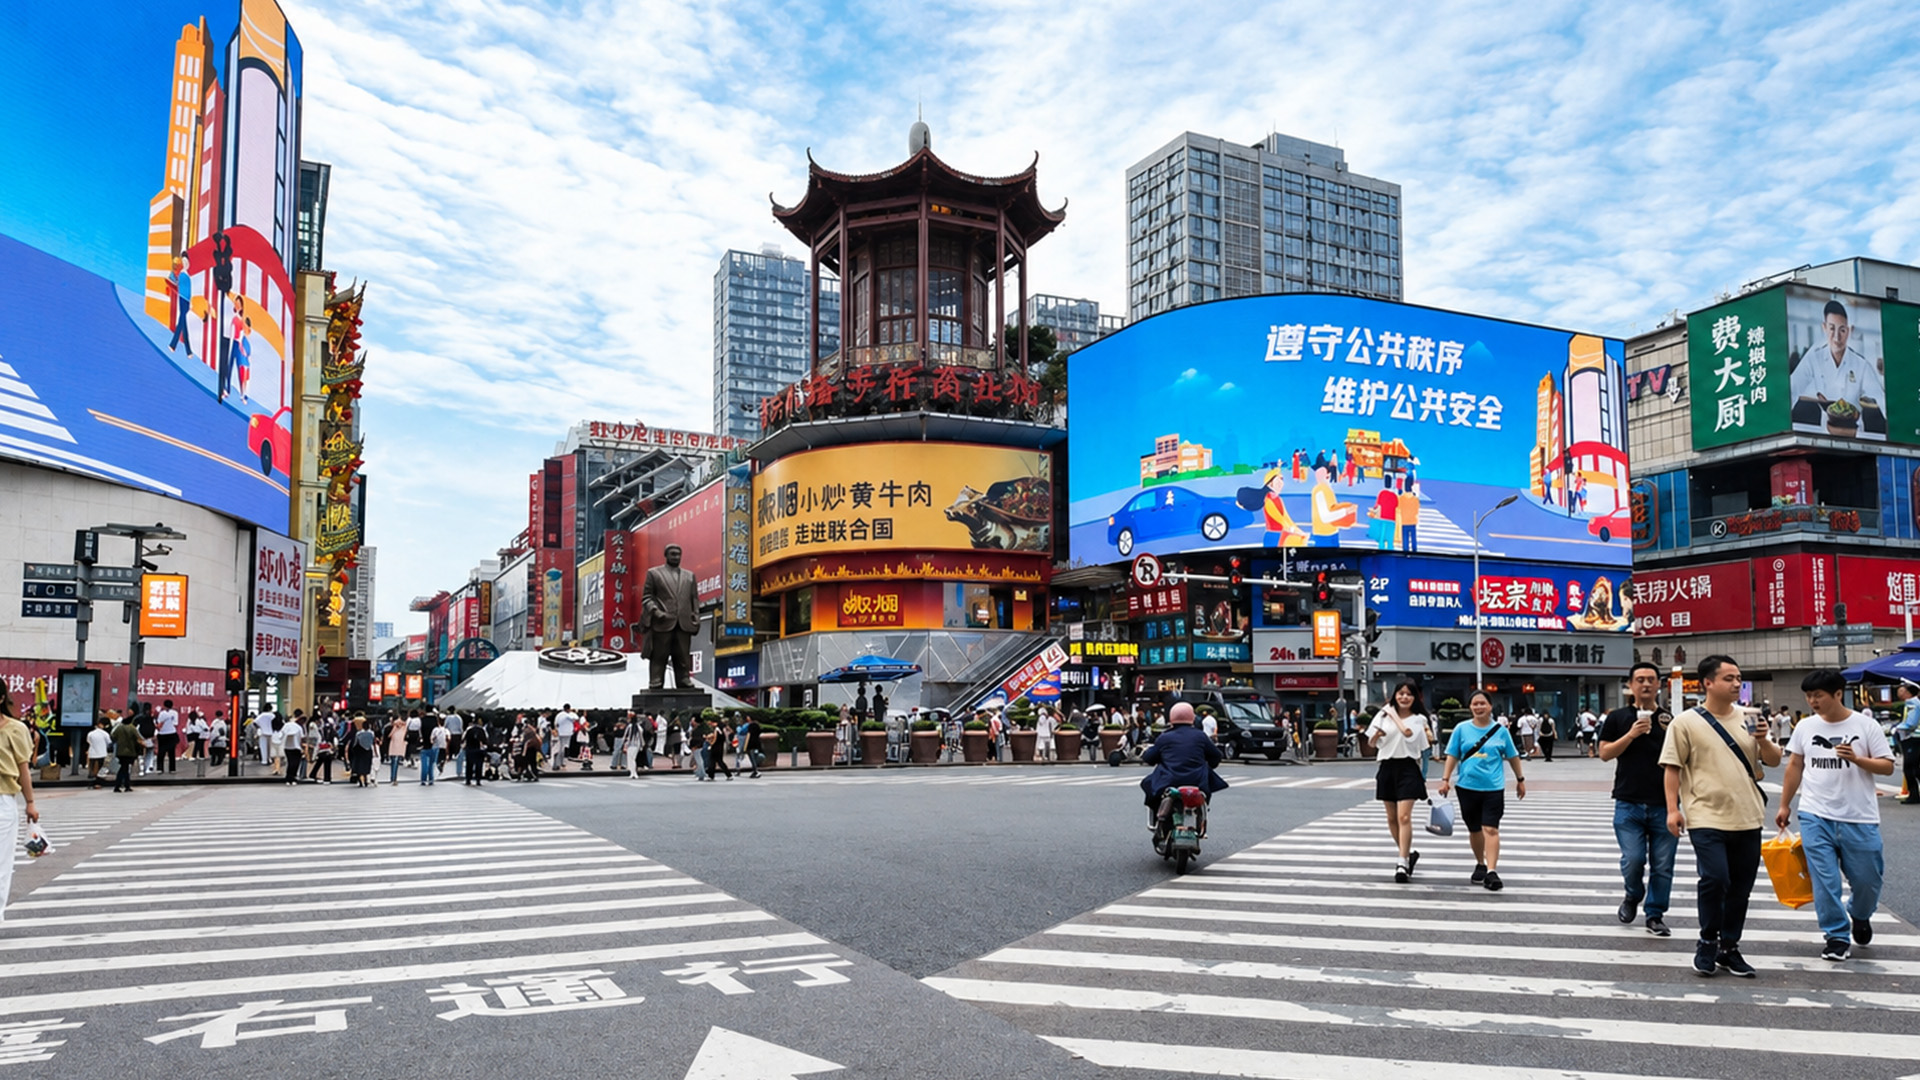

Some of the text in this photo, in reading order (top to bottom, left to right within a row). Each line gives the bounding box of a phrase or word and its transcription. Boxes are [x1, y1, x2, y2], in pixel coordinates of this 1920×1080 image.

[1264, 323, 1465, 376] 遵守公共秩序
[1712, 315, 1748, 432] 费大厨
[1320, 376, 1503, 430] 维护公共安全
[795, 518, 893, 545] 走进联合国
